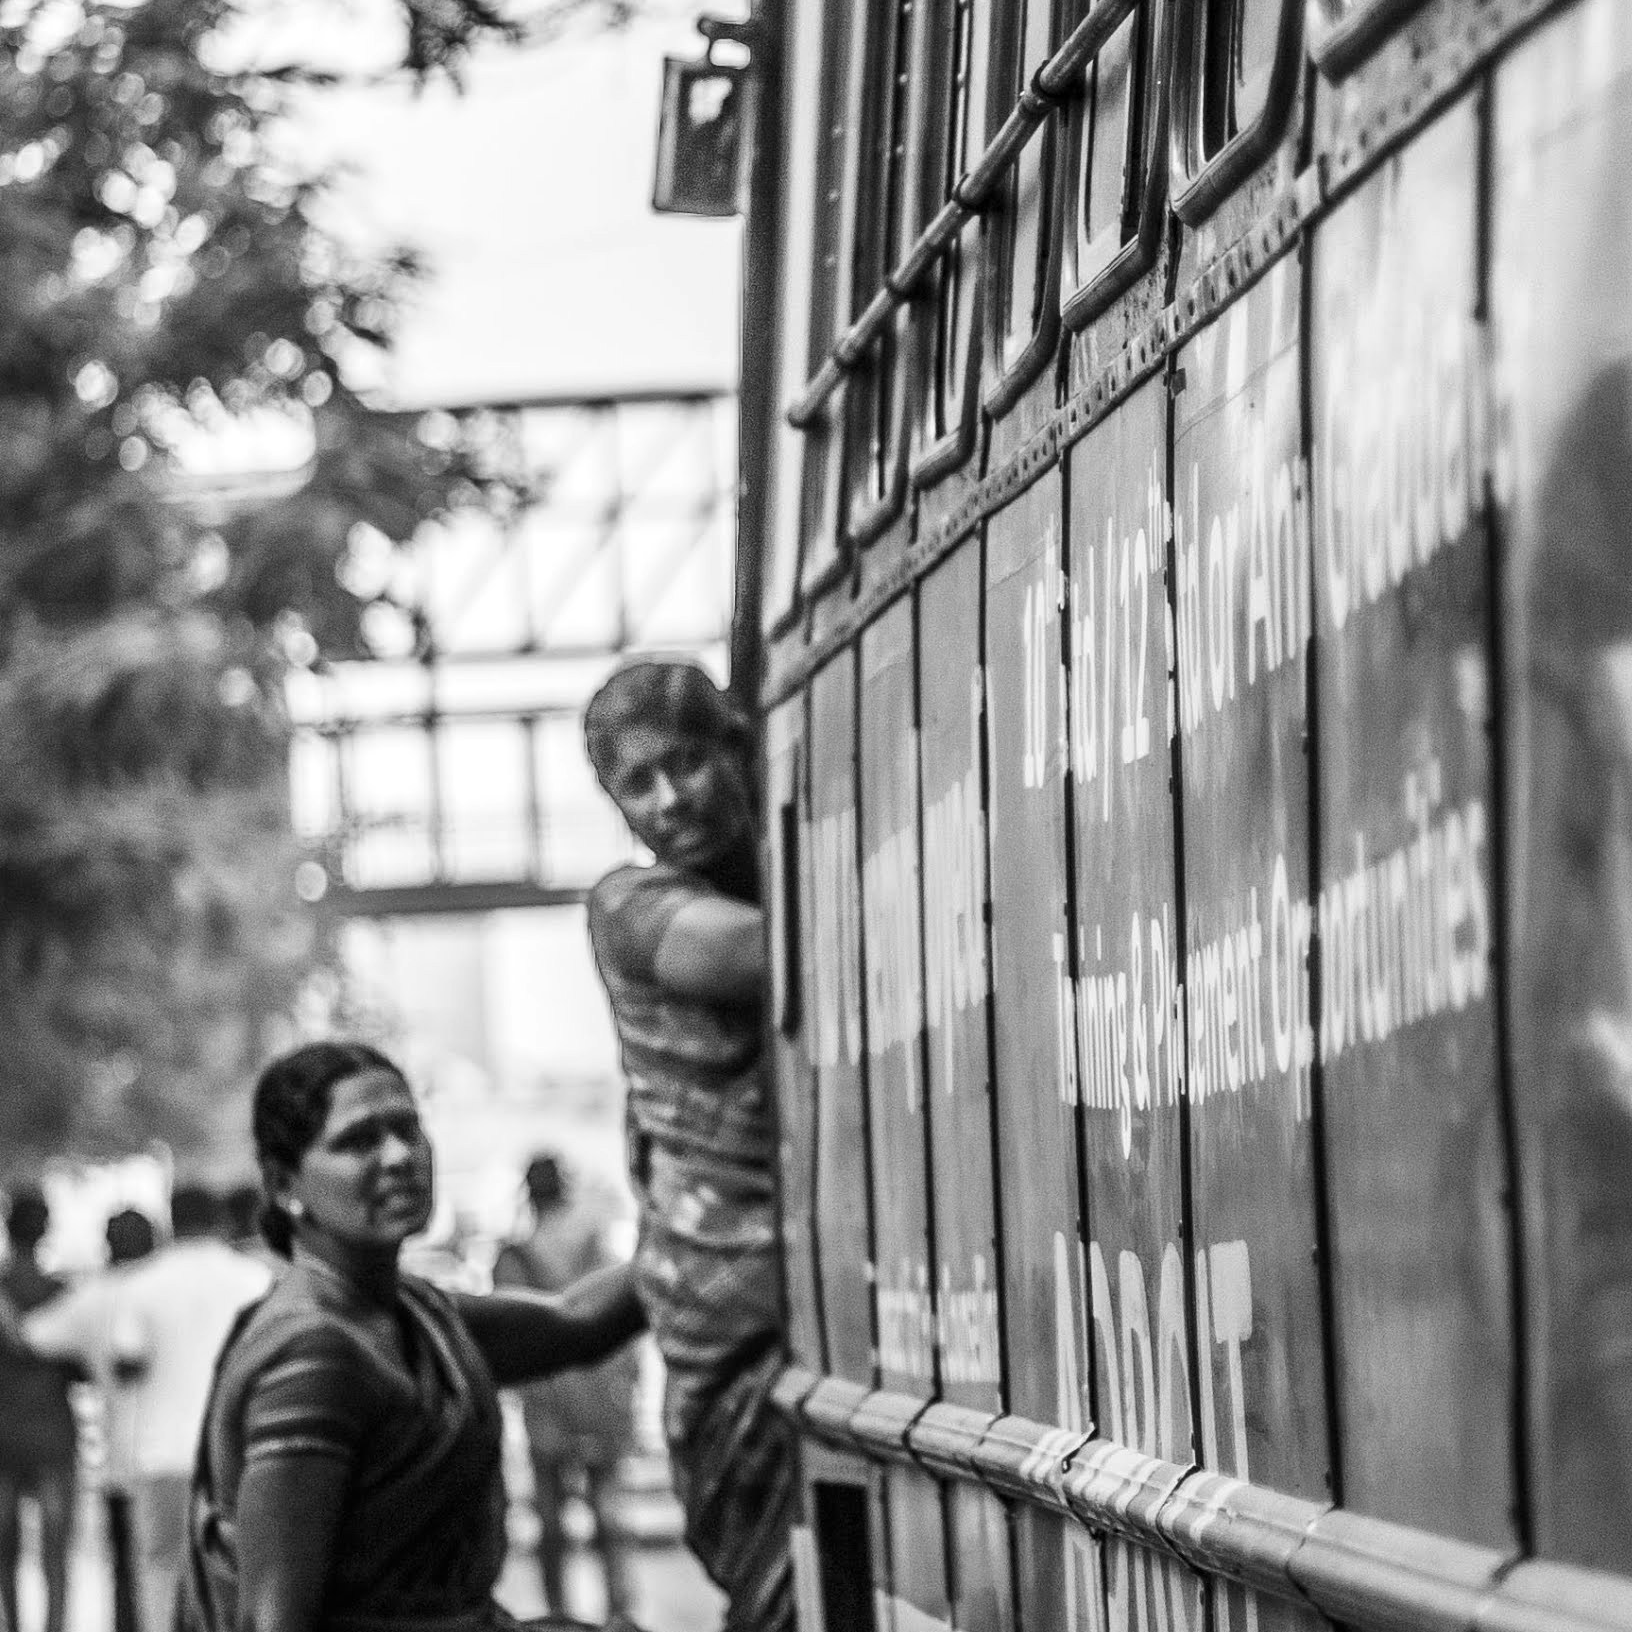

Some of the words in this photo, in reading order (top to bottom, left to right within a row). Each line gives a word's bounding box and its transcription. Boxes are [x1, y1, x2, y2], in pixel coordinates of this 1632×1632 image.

[1208, 503, 1240, 713] or
[1052, 923, 1131, 1160] Training
[1131, 910, 1150, 1112] &
[1150, 885, 1266, 1110] Placement
[1271, 757, 1488, 1123] Opportunities
